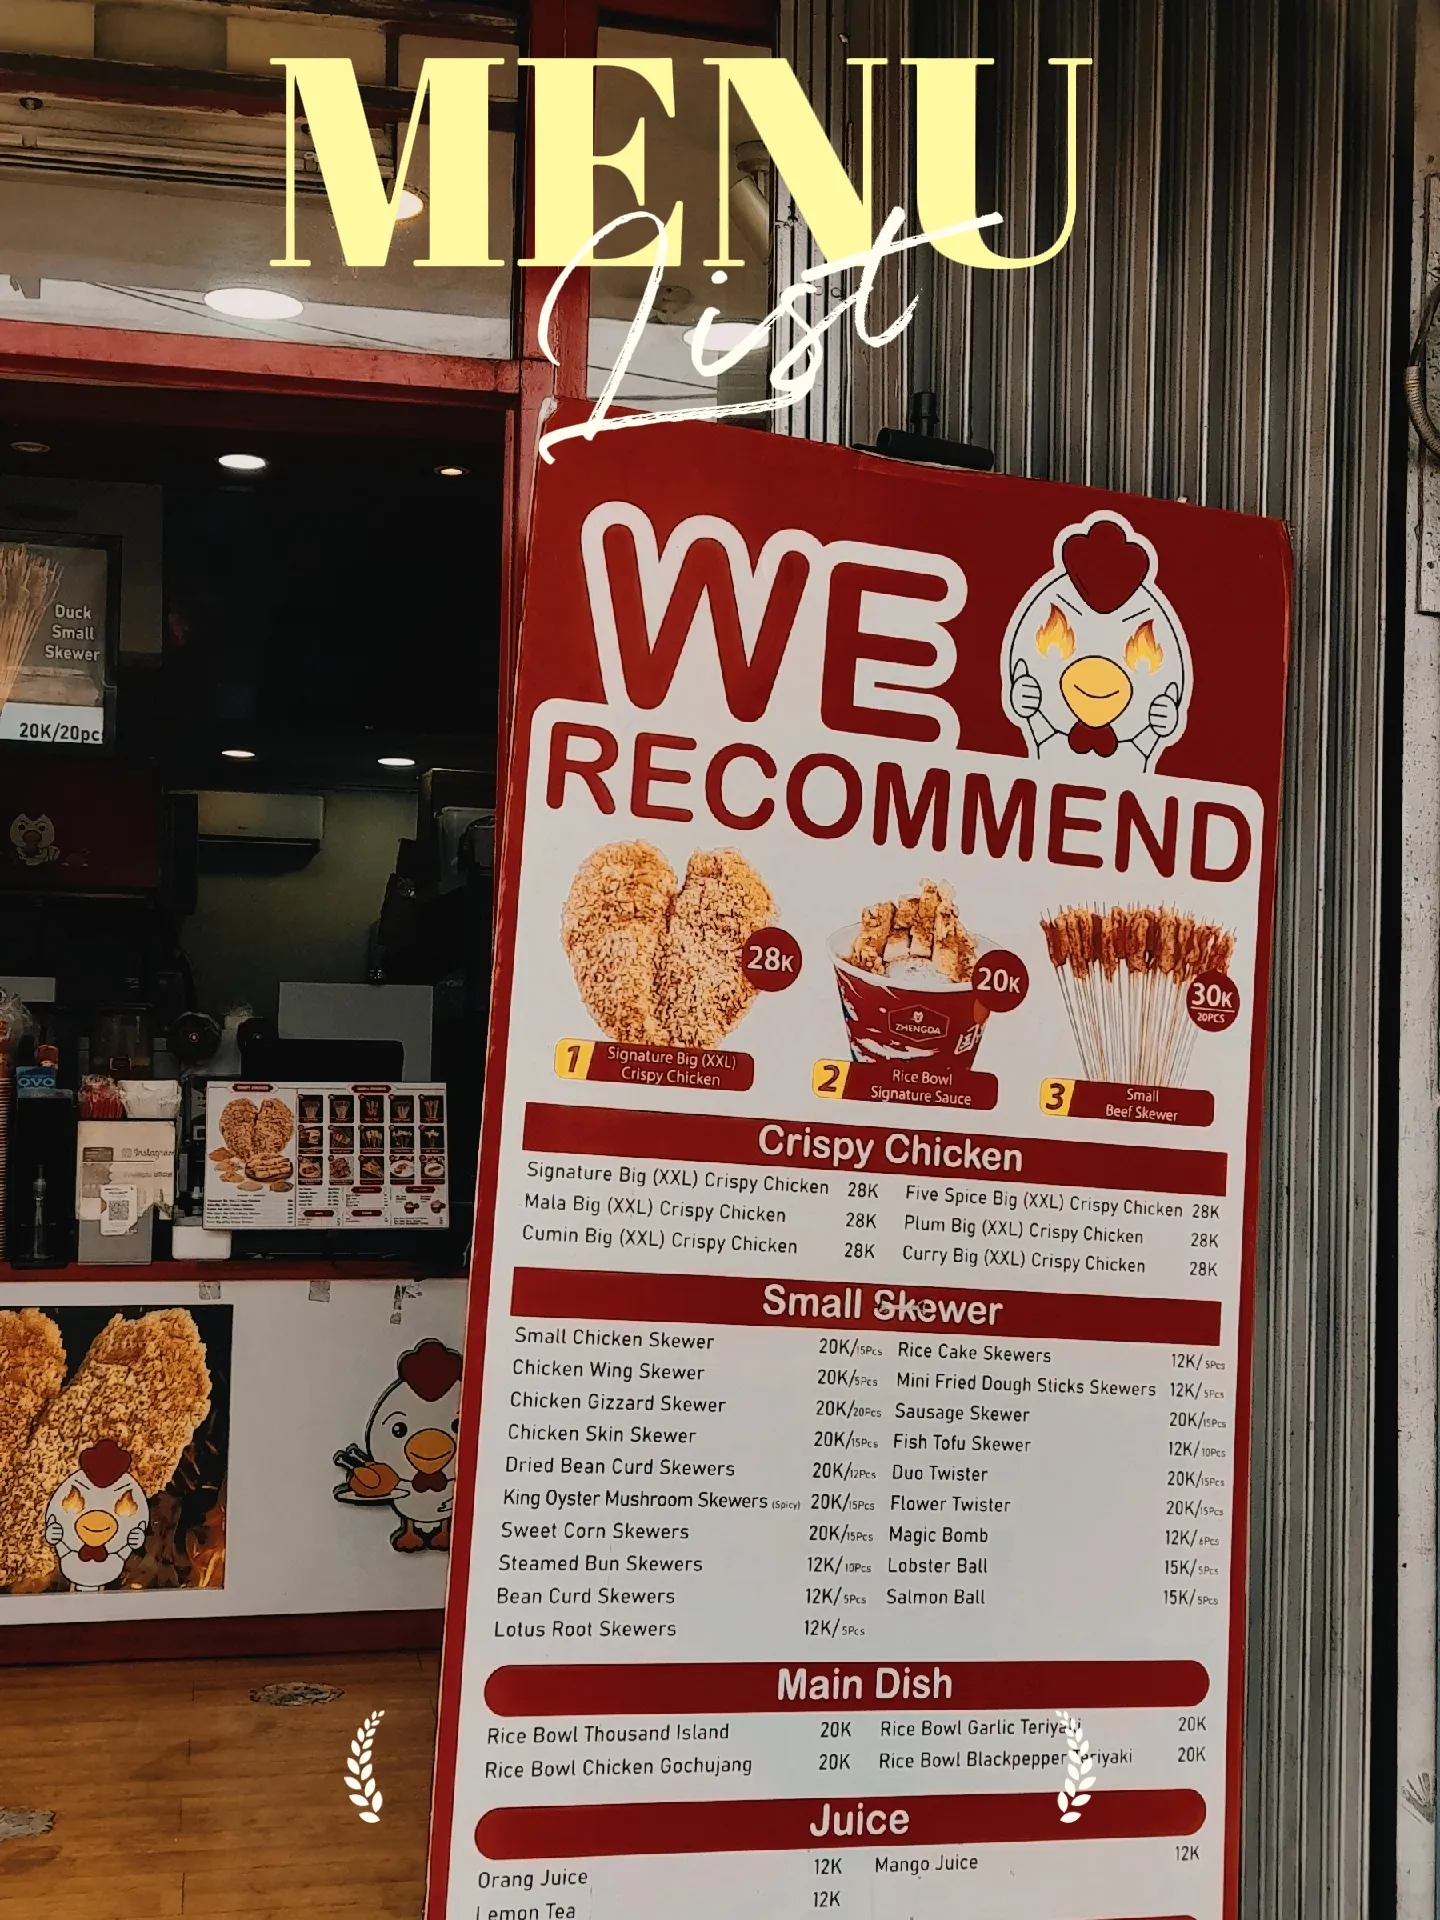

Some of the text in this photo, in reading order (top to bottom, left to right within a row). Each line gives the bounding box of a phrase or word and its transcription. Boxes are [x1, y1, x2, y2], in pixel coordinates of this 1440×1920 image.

[54, 604, 92, 619] Duck
[51, 625, 95, 640] Small
[599, 521, 951, 743] WE
[44, 645, 100, 661] Skewer
[545, 721, 1252, 882] RECOMMEND
[747, 946, 794, 973] 28K
[977, 967, 1020, 994] 20K
[1191, 982, 1232, 1008] 30K
[1197, 1012, 1225, 1024] 20PCS
[567, 1046, 580, 1072] 1
[608, 1046, 736, 1070] Signature Big (XXL)
[18, 1078, 54, 1086] OVO
[622, 1066, 720, 1086] Crispy Chicken
[818, 1065, 839, 1091] 2
[893, 1069, 952, 1085] Rice Bowl
[871, 1086, 971, 1105] Signature Sauce
[1046, 1083, 1066, 1110] 3
[1127, 1089, 1159, 1102] Small
[1105, 1105, 1178, 1121] Beef Skewer
[759, 1124, 1023, 1172] Crispy Chicken
[527, 1162, 878, 1198] Signature Big (XXL) Crispy Chicken 28K
[526, 1193, 876, 1229] Mala Big (XXL) Crispy Chicken 28K
[906, 1185, 1220, 1219] Five Spice Big (XXL) Crispy Chicken 28K
[523, 1224, 875, 1258] Cumin Big (XXL) Crispy Chicken 28K
[905, 1214, 1218, 1248] Plum Big (XXL) Crispy Chicken 28K
[903, 1245, 1218, 1277] Curry Big (XXL) Crispy Chicken 28K
[763, 1284, 1003, 1326] Small Skewer
[515, 1326, 714, 1349] Small Chicken Skewer
[898, 1342, 1051, 1363] Rice Cake Skewers
[514, 1359, 582, 1377] Chicken
[590, 1361, 632, 1382] Wing
[639, 1363, 705, 1380] Skewer
[898, 1372, 1156, 1396] Mini Fried Dough Sticks Skewers
[511, 1391, 581, 1409] Chicken
[588, 1394, 654, 1410] Gizzard
[661, 1395, 726, 1412] Skewer
[895, 1402, 1030, 1424] Sausage Skewer
[509, 1424, 697, 1443] Chicken Skin Skewer
[894, 1433, 1031, 1452] Fish Tofu Skewer
[506, 1456, 734, 1476] Dried Bean Curd Skewers
[893, 1464, 988, 1481] Duo Twister
[504, 1489, 800, 1510] King Oyster Mushroom Skewers (Spicy)
[891, 1495, 1011, 1512] Flower Twister
[502, 1522, 689, 1539] Sweet Corn Skewers
[890, 1526, 988, 1546] Magic Bomb
[499, 1554, 702, 1572] Steamed Bun Skewers
[889, 1558, 987, 1574] Lobster Ball
[498, 1587, 674, 1604] Bean Curd Skewers
[887, 1588, 985, 1604] Salmon Ball
[495, 1621, 676, 1637] Lotus Root Skewers
[777, 1666, 952, 1701] Main Dish
[488, 1722, 851, 1744] Rice Bowl Thousand Island 20K
[1179, 1716, 1206, 1731] 20K
[1178, 1746, 1206, 1762] 20K
[486, 1754, 850, 1778] Rice Bowl Chicken Gochujang 20K
[809, 1803, 910, 1837] Juice
[876, 1845, 1199, 1875] Mango Juice 12K
[478, 1858, 842, 1891] Orang Juice 12K
